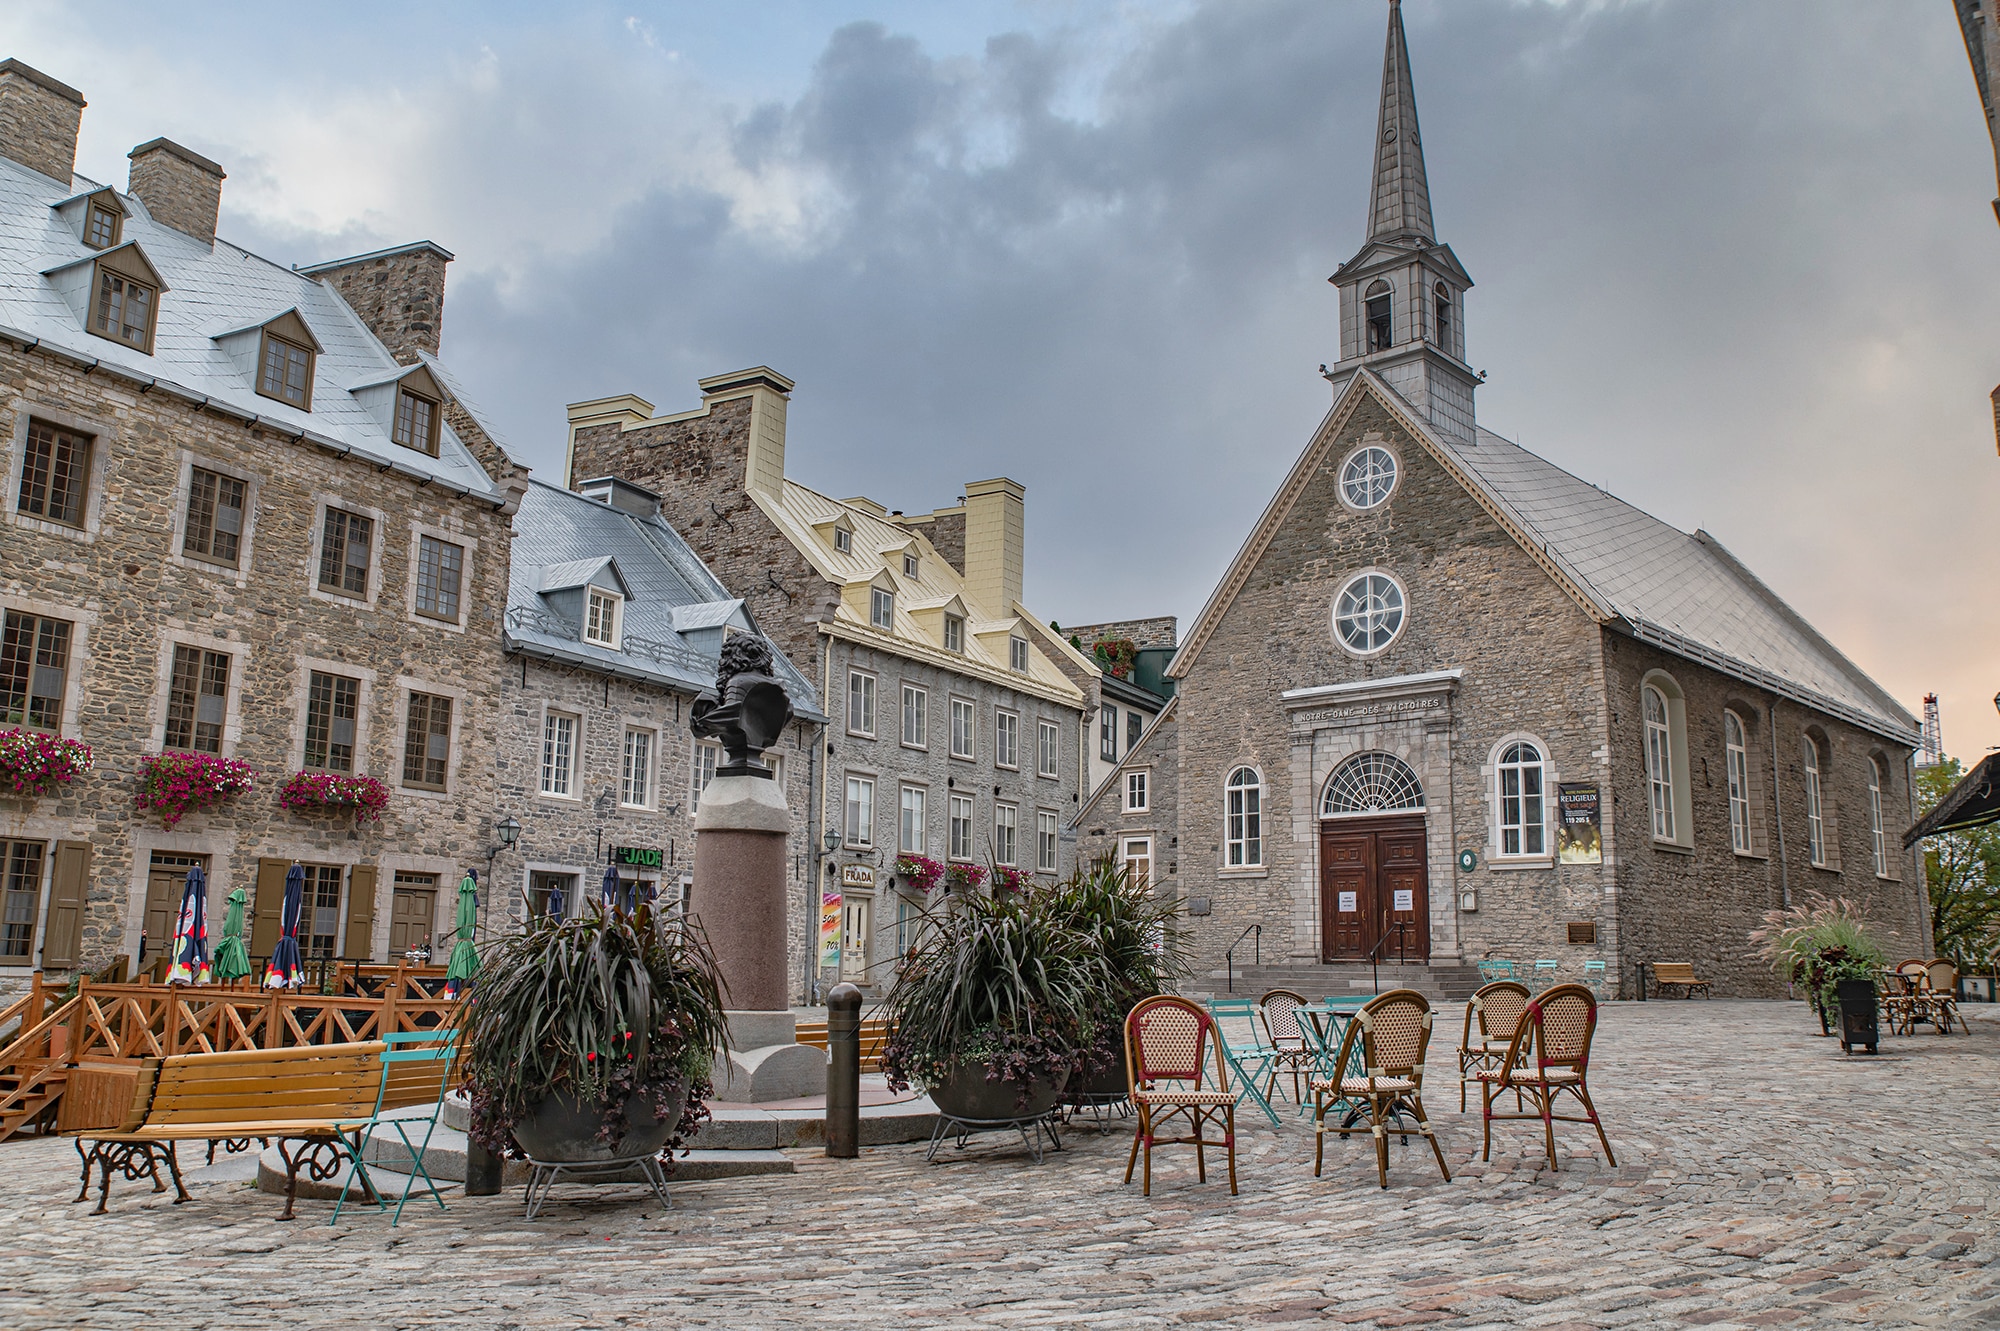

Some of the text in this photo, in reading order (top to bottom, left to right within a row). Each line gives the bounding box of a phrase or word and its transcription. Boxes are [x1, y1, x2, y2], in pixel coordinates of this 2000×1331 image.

[1300, 698, 1440, 722] NOTRE-DAME DES VICTOIRES
[619, 847, 662, 867] LE JADE
[845, 870, 872, 882] FRADA
[822, 914, 837, 923] 50%
[826, 940, 839, 950] 70%
